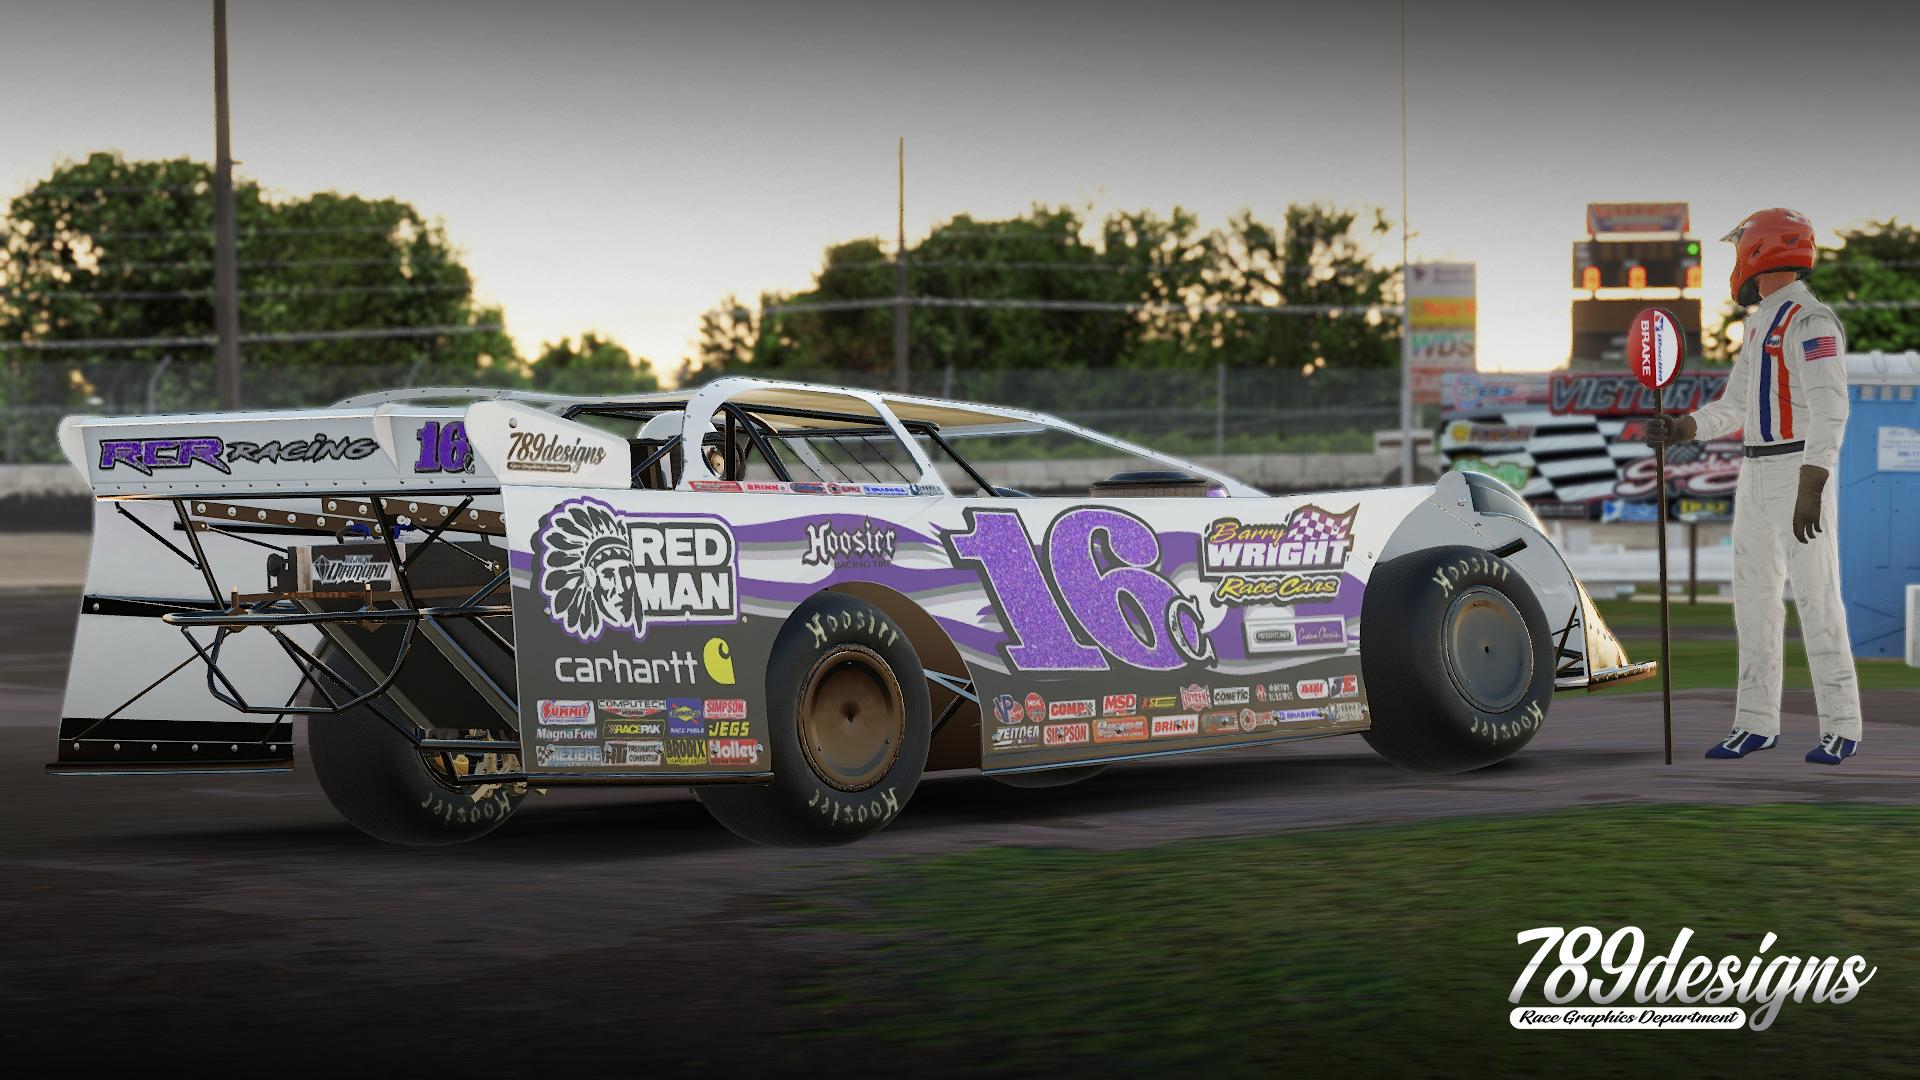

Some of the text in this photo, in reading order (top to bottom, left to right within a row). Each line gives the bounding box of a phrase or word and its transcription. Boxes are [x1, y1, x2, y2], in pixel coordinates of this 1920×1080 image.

[1641, 319, 1651, 376] BRAKE
[1552, 376, 1728, 412] VICTORY
[99, 433, 380, 476] RCR RACING
[507, 431, 606, 474] 789designs
[631, 527, 728, 566] RED
[801, 515, 896, 566] Hoosier
[1210, 521, 1286, 548] Barry
[1208, 539, 1351, 567] WRIGHT
[636, 572, 730, 609] MAN
[1217, 576, 1338, 597] Race Cars
[1432, 553, 1511, 598] Hoosier
[805, 609, 899, 648] Hoosier
[554, 649, 698, 684] carhartt
[598, 699, 666, 709] COMPUTECH
[1104, 695, 1136, 710] MSD
[1331, 675, 1357, 698] JE
[706, 700, 744, 713] SIMPSON
[1051, 703, 1085, 717] COMP
[1470, 700, 1543, 745] Hoosier
[536, 728, 598, 742] MagnaFuel
[614, 724, 660, 734] RACEPAK
[709, 721, 750, 737] JEGS
[709, 740, 758, 764] Holley
[420, 790, 512, 826] Hoosier
[808, 786, 899, 827] Hoosier
